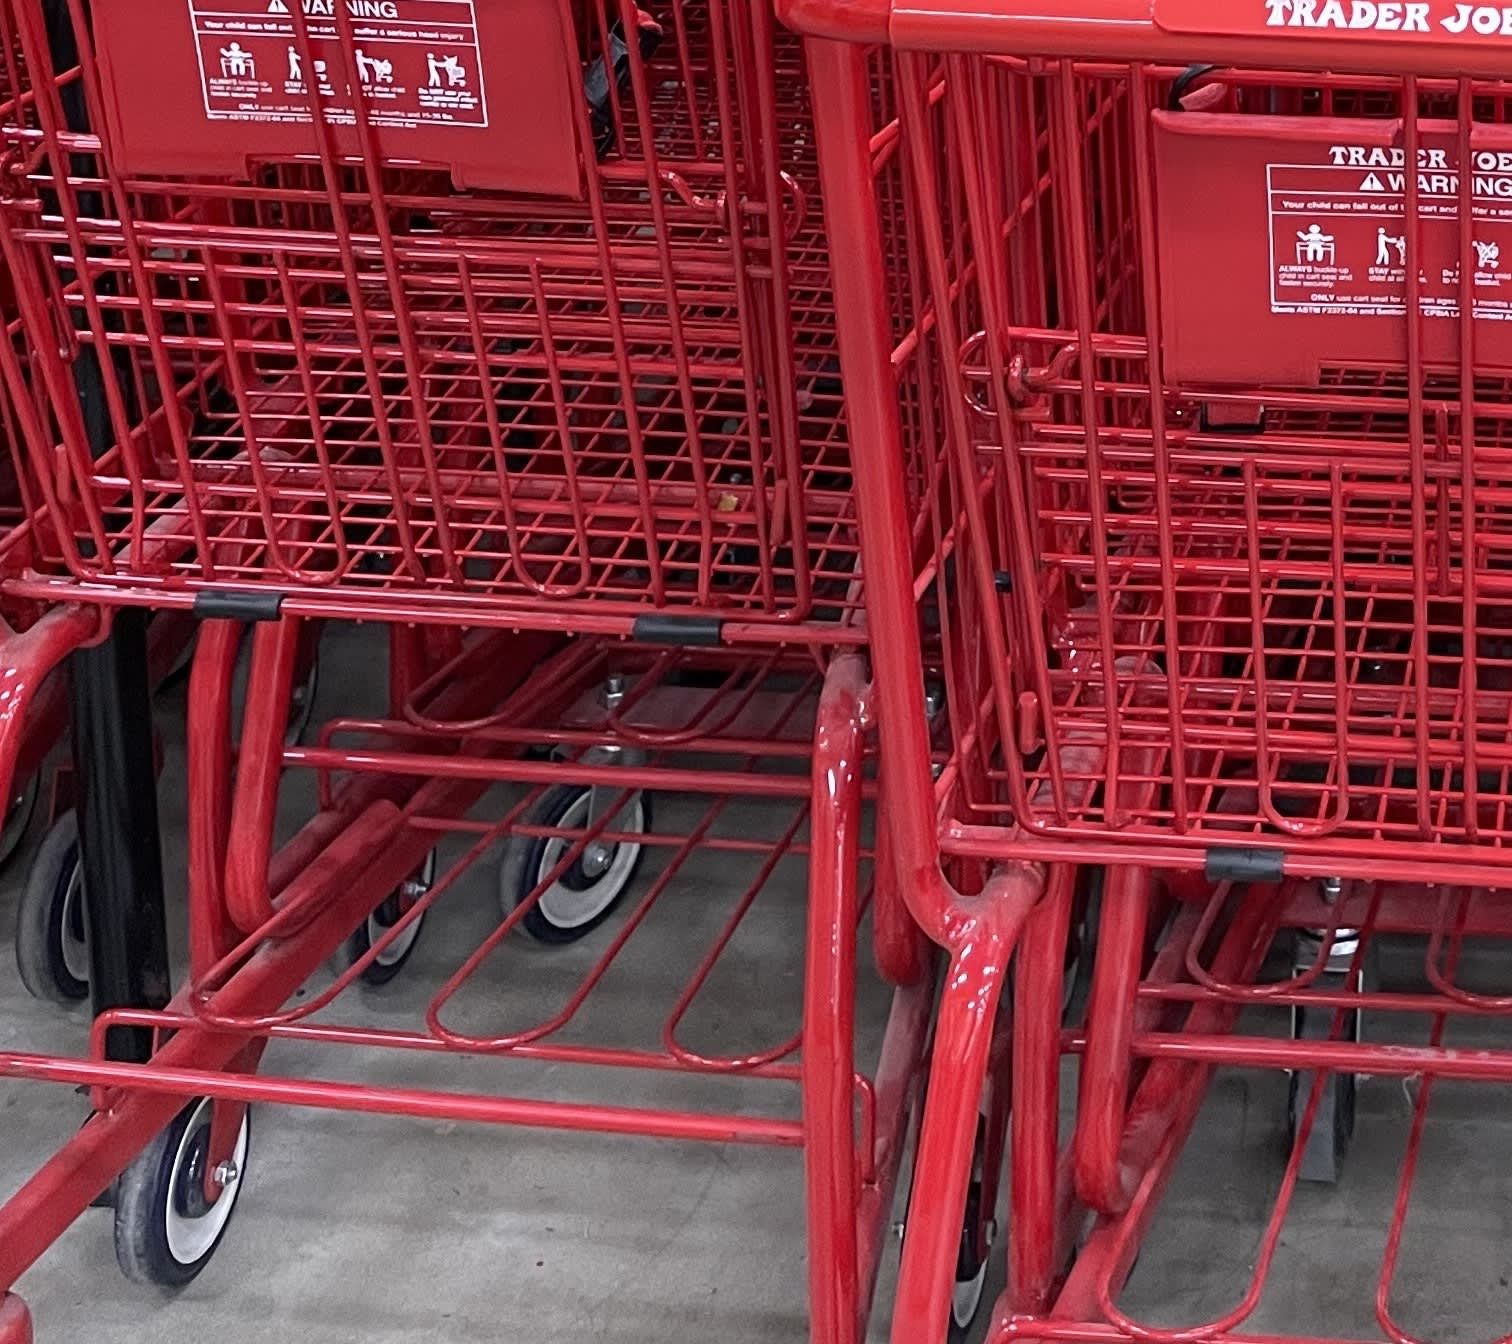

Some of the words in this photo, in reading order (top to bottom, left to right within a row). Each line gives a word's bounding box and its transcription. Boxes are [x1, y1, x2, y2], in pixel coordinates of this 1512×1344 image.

[1282, 200, 1305, 209] Your
[1307, 201, 1331, 209] child
[1353, 202, 1368, 210] fall
[1370, 203, 1386, 211] out
